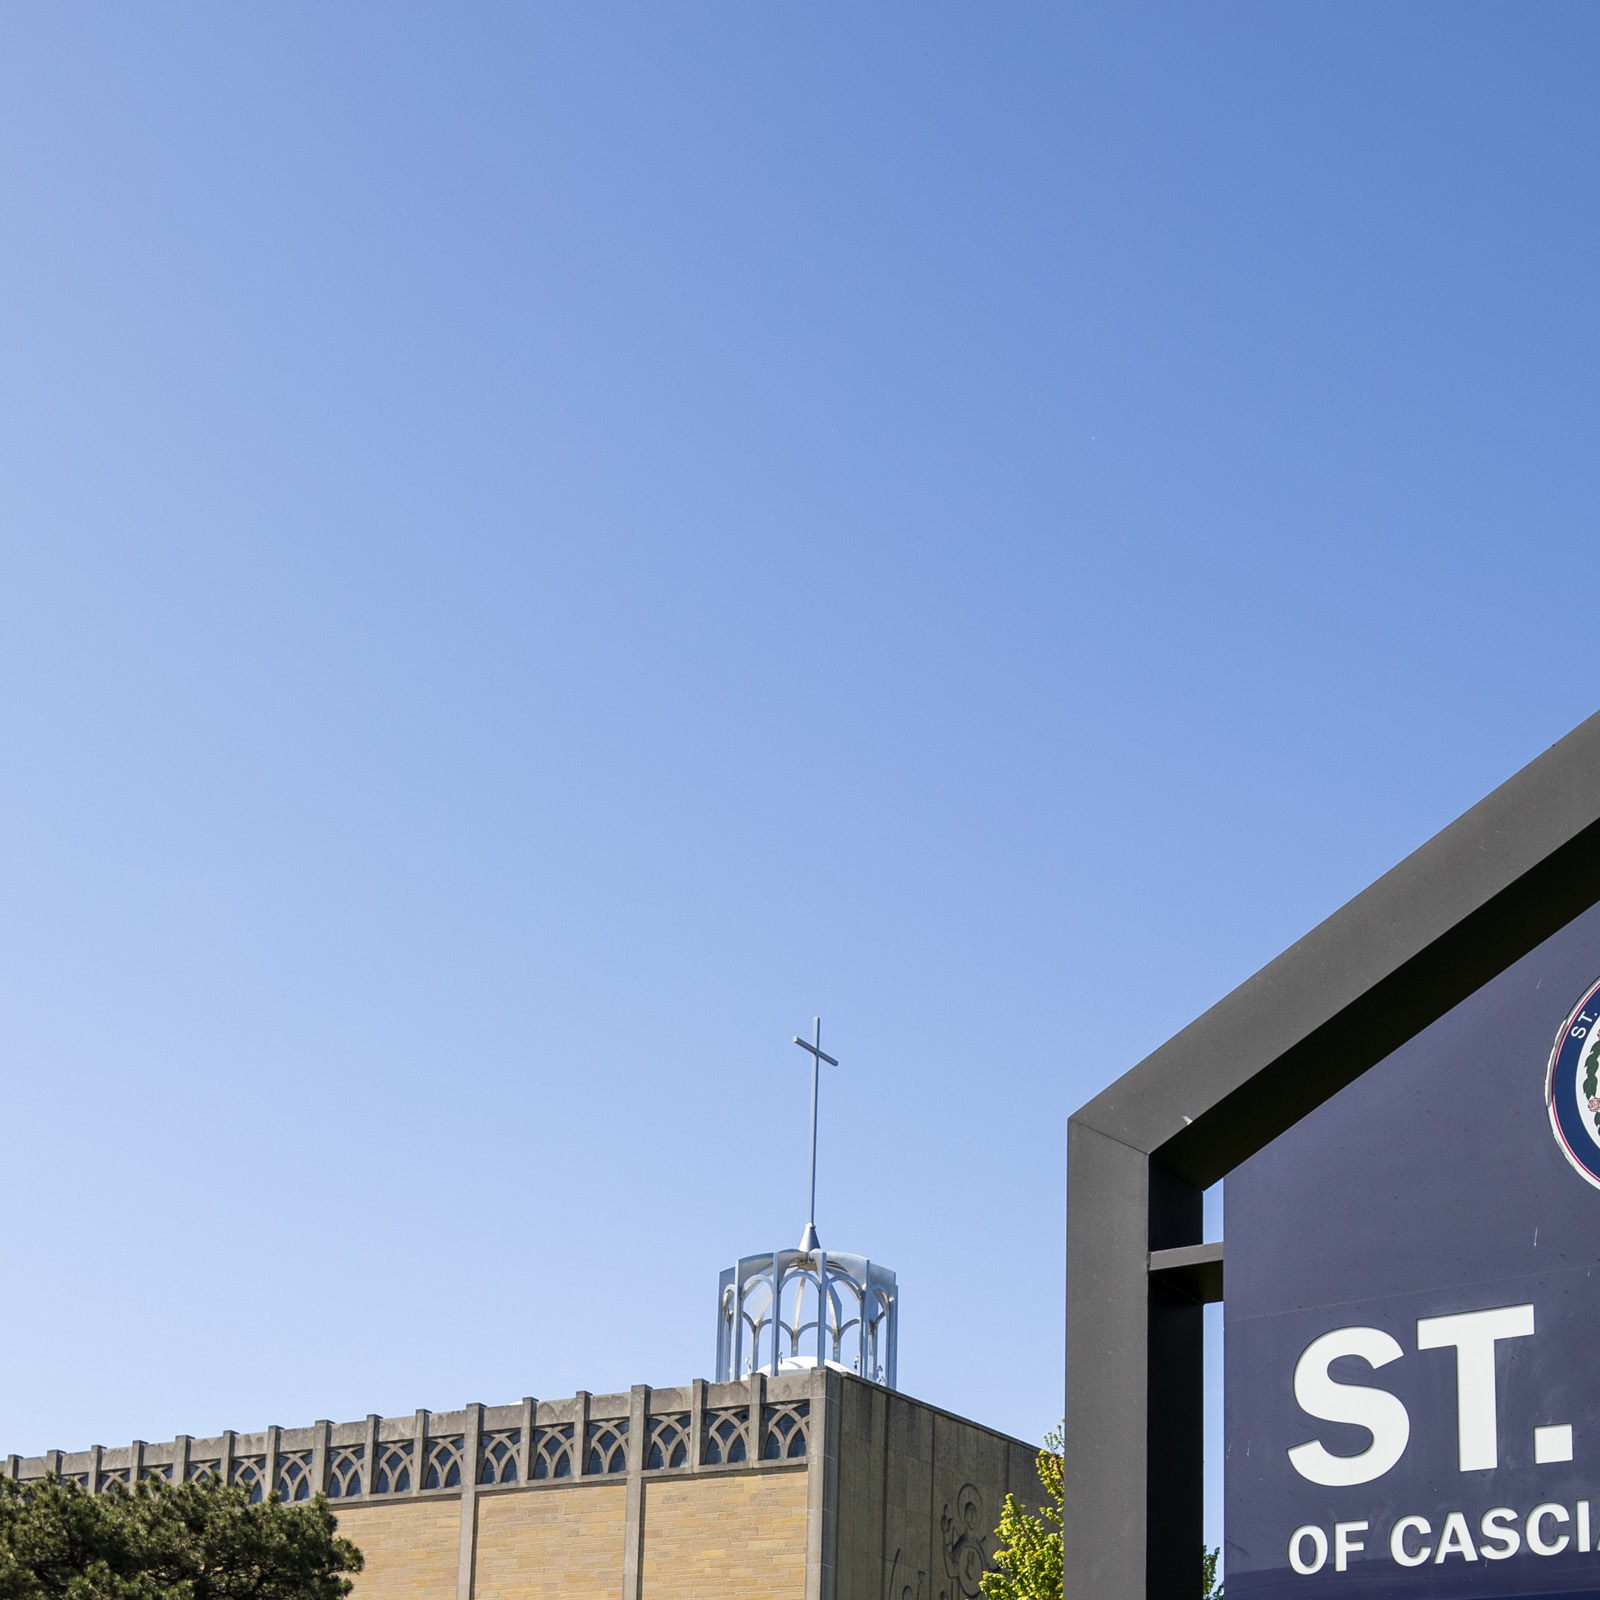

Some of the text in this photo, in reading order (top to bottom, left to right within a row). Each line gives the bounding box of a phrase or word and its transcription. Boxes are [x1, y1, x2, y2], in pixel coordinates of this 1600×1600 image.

[1571, 1010, 1599, 1039] ST.
[1286, 1303, 1573, 1487] ST.
[1287, 1519, 1370, 1575] OF
